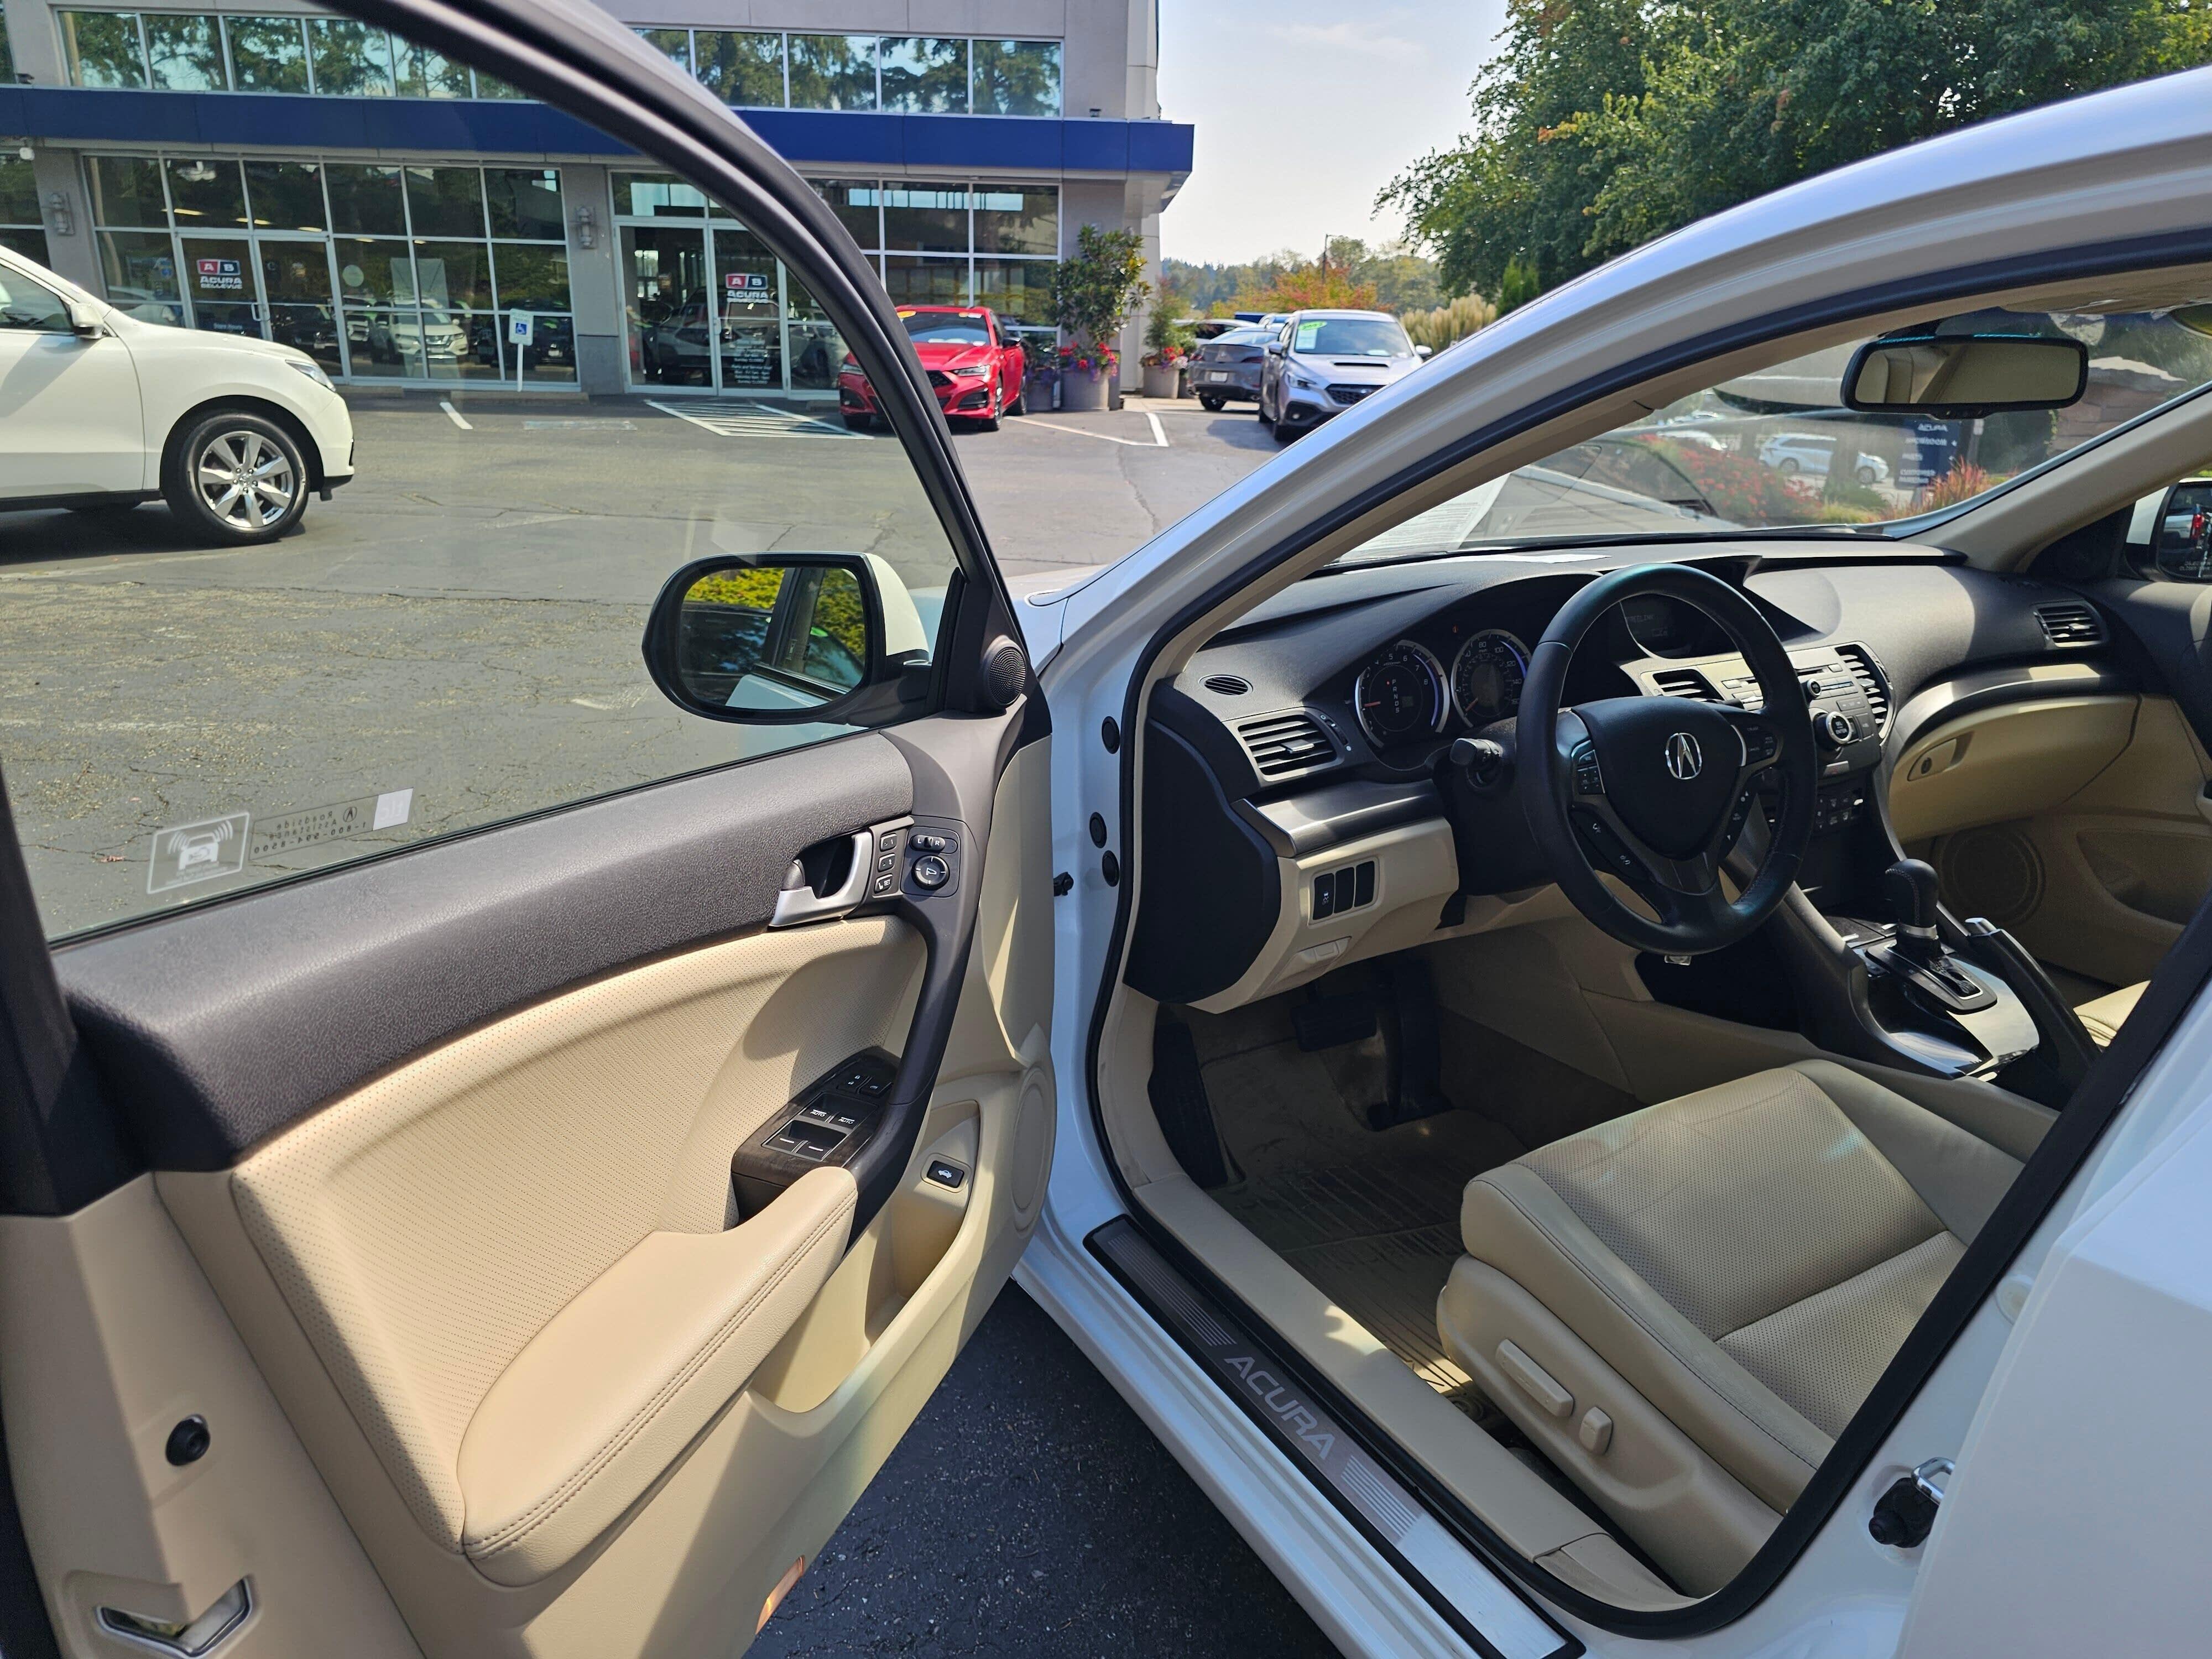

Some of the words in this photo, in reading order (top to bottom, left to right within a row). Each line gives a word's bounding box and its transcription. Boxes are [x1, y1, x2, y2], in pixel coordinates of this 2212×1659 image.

[200, 275, 243, 284] ACURA
[727, 290, 768, 299] ACURA
[1917, 423, 1948, 432] ACURA
[1224, 1355, 1336, 1461] ACURA
